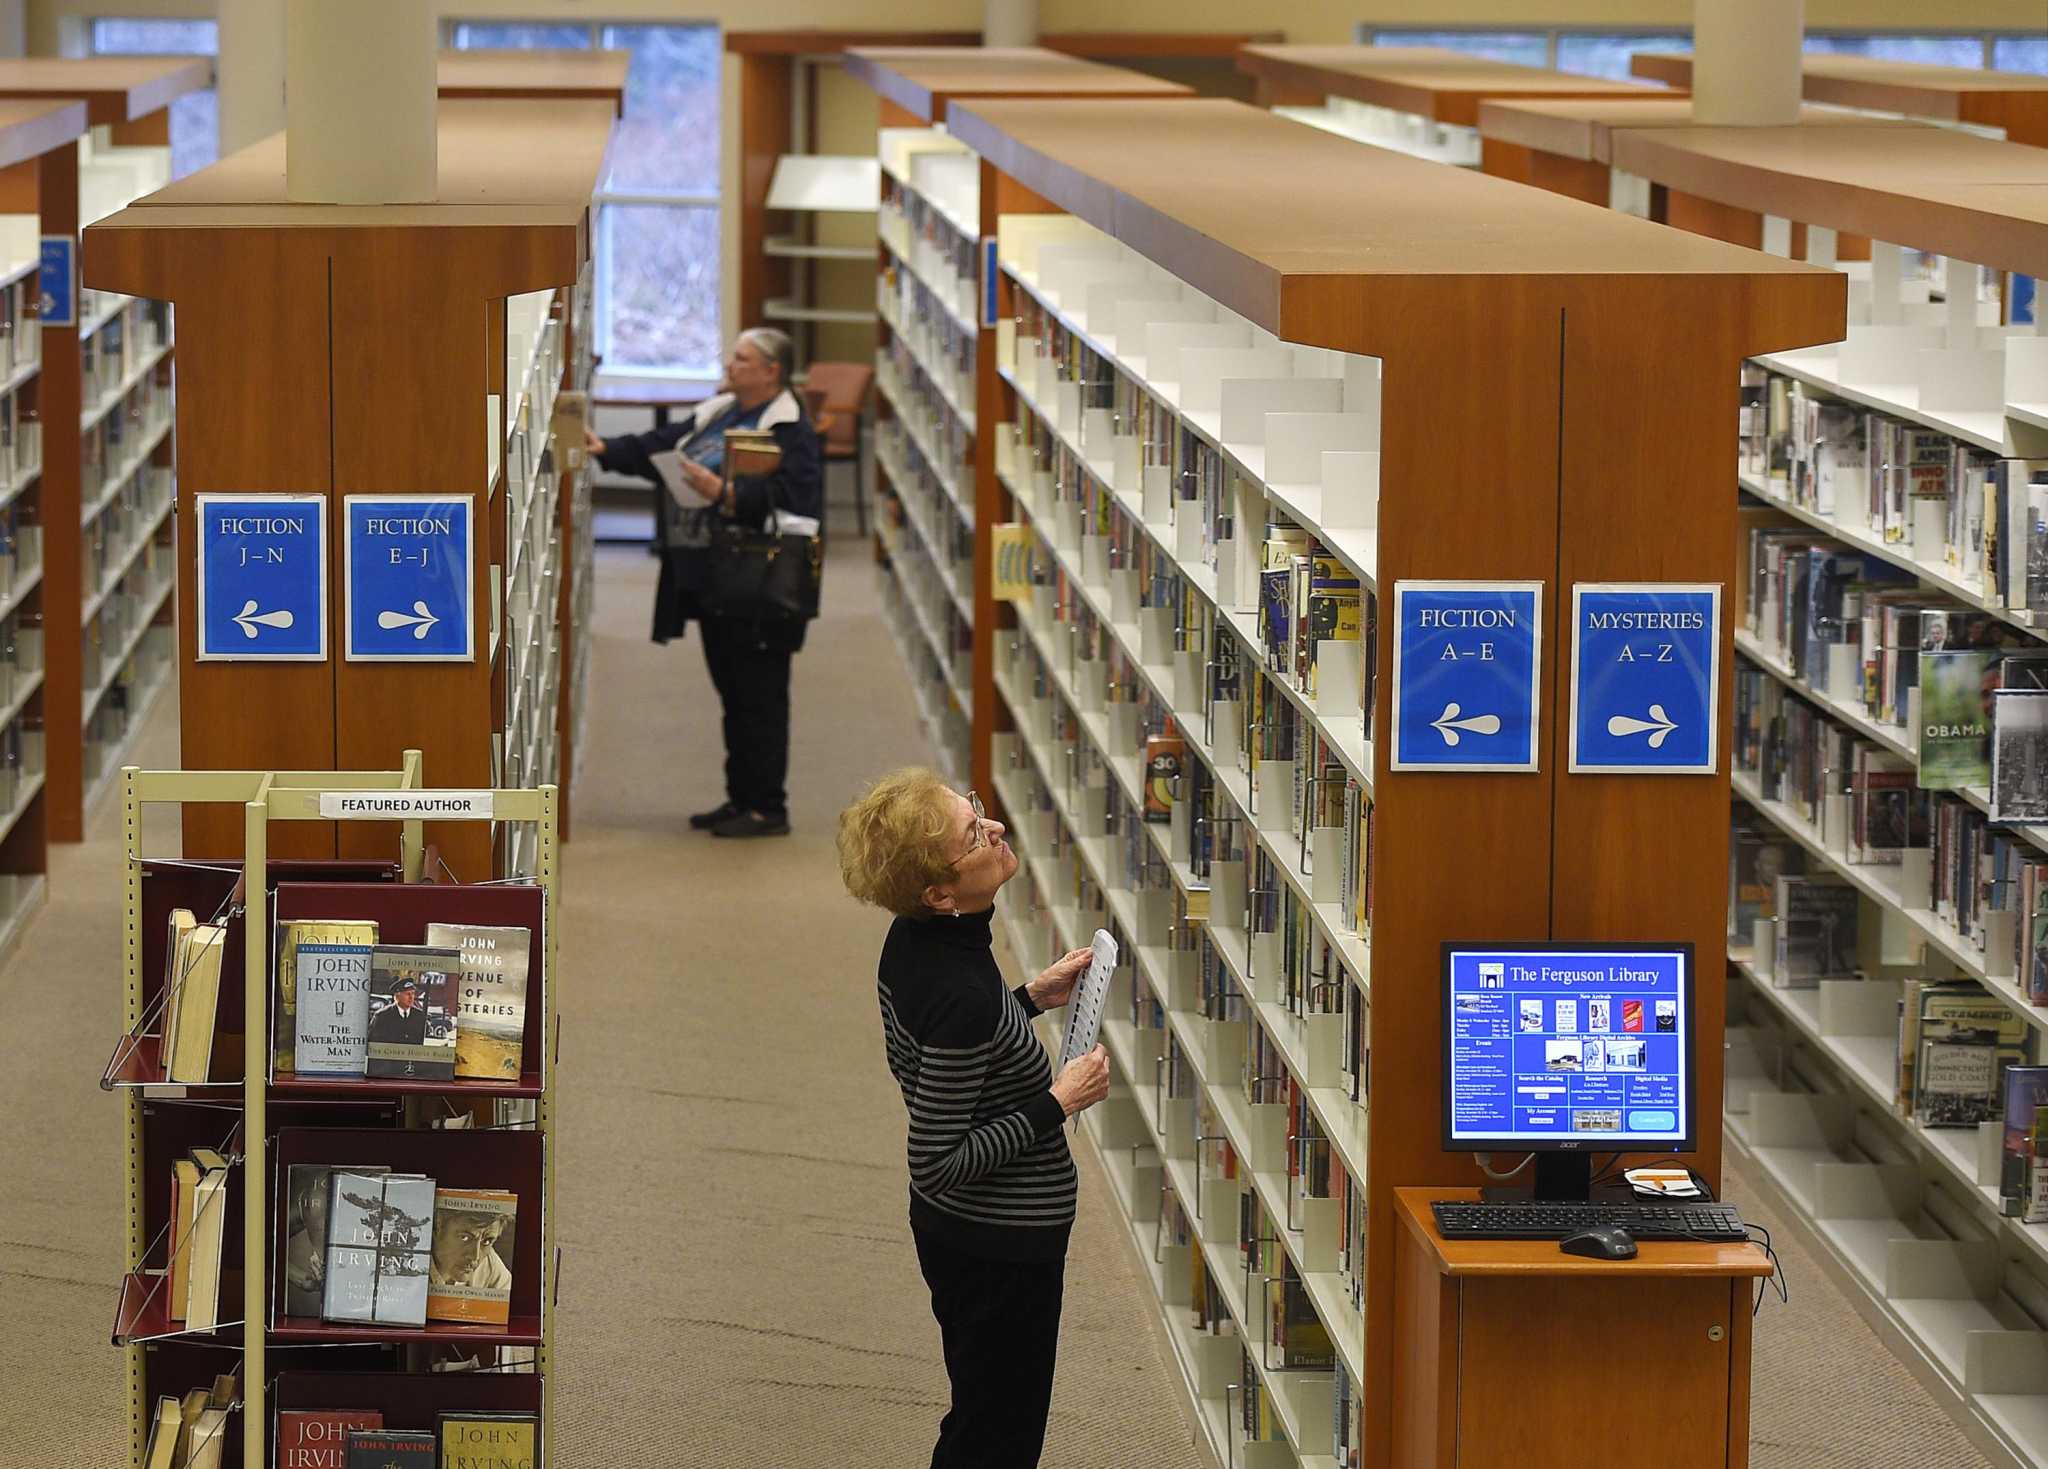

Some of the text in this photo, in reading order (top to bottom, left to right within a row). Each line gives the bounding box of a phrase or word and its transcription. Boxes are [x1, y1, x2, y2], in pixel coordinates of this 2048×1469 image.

[220, 517, 305, 535] FICTION
[366, 518, 451, 536] FICTION
[1418, 609, 1517, 629] FICTION
[1586, 611, 1704, 630] MYSTERIES
[1926, 724, 1986, 738] OBAMA
[1154, 757, 1176, 770] 30
[341, 799, 472, 812] FEATURED AUTHOR
[460, 937, 496, 950] JOHN
[316, 958, 368, 975] JOHN
[1510, 967, 1660, 986] The Ferguson Library
[465, 988, 485, 999] OF
[328, 1024, 352, 1035] THE
[327, 1046, 352, 1057] MAN
[350, 1228, 410, 1245] JOHN
[337, 1251, 420, 1271] IRVING
[457, 1426, 519, 1444] JOHN
[353, 1441, 434, 1452] JOHN IRVING
[444, 1453, 532, 1469] IRVING
